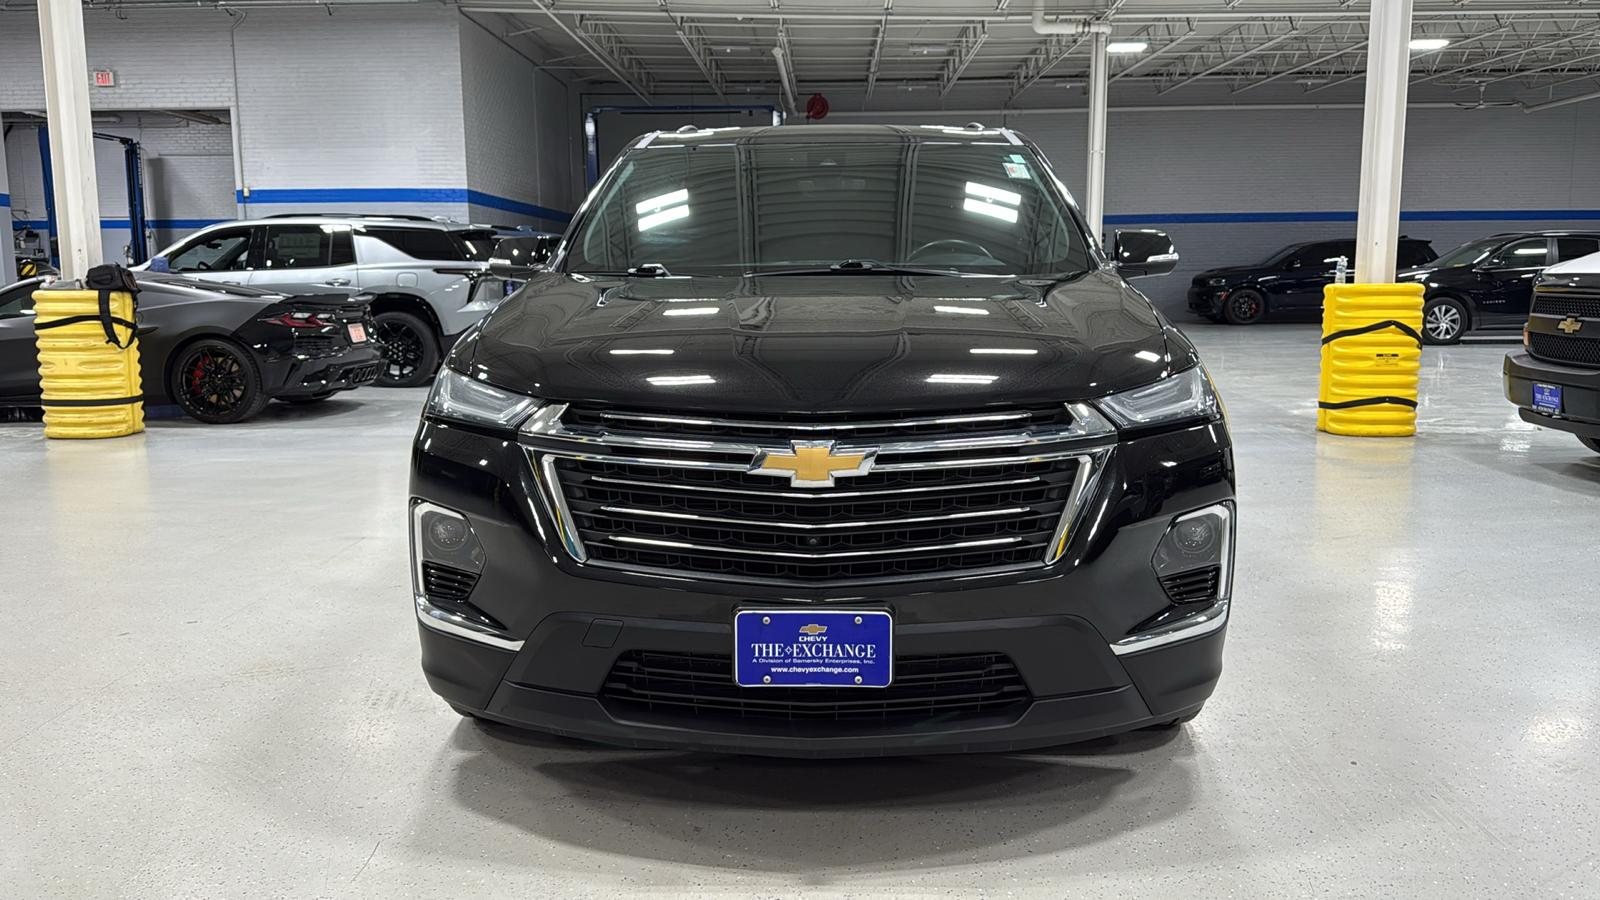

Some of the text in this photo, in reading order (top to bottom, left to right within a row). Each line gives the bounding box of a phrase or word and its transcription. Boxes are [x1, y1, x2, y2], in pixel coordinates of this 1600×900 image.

[96, 72, 110, 85] EXIT
[751, 643, 876, 658] THE EXCHANGE
[771, 666, 859, 674] www.chevyexchange.com
